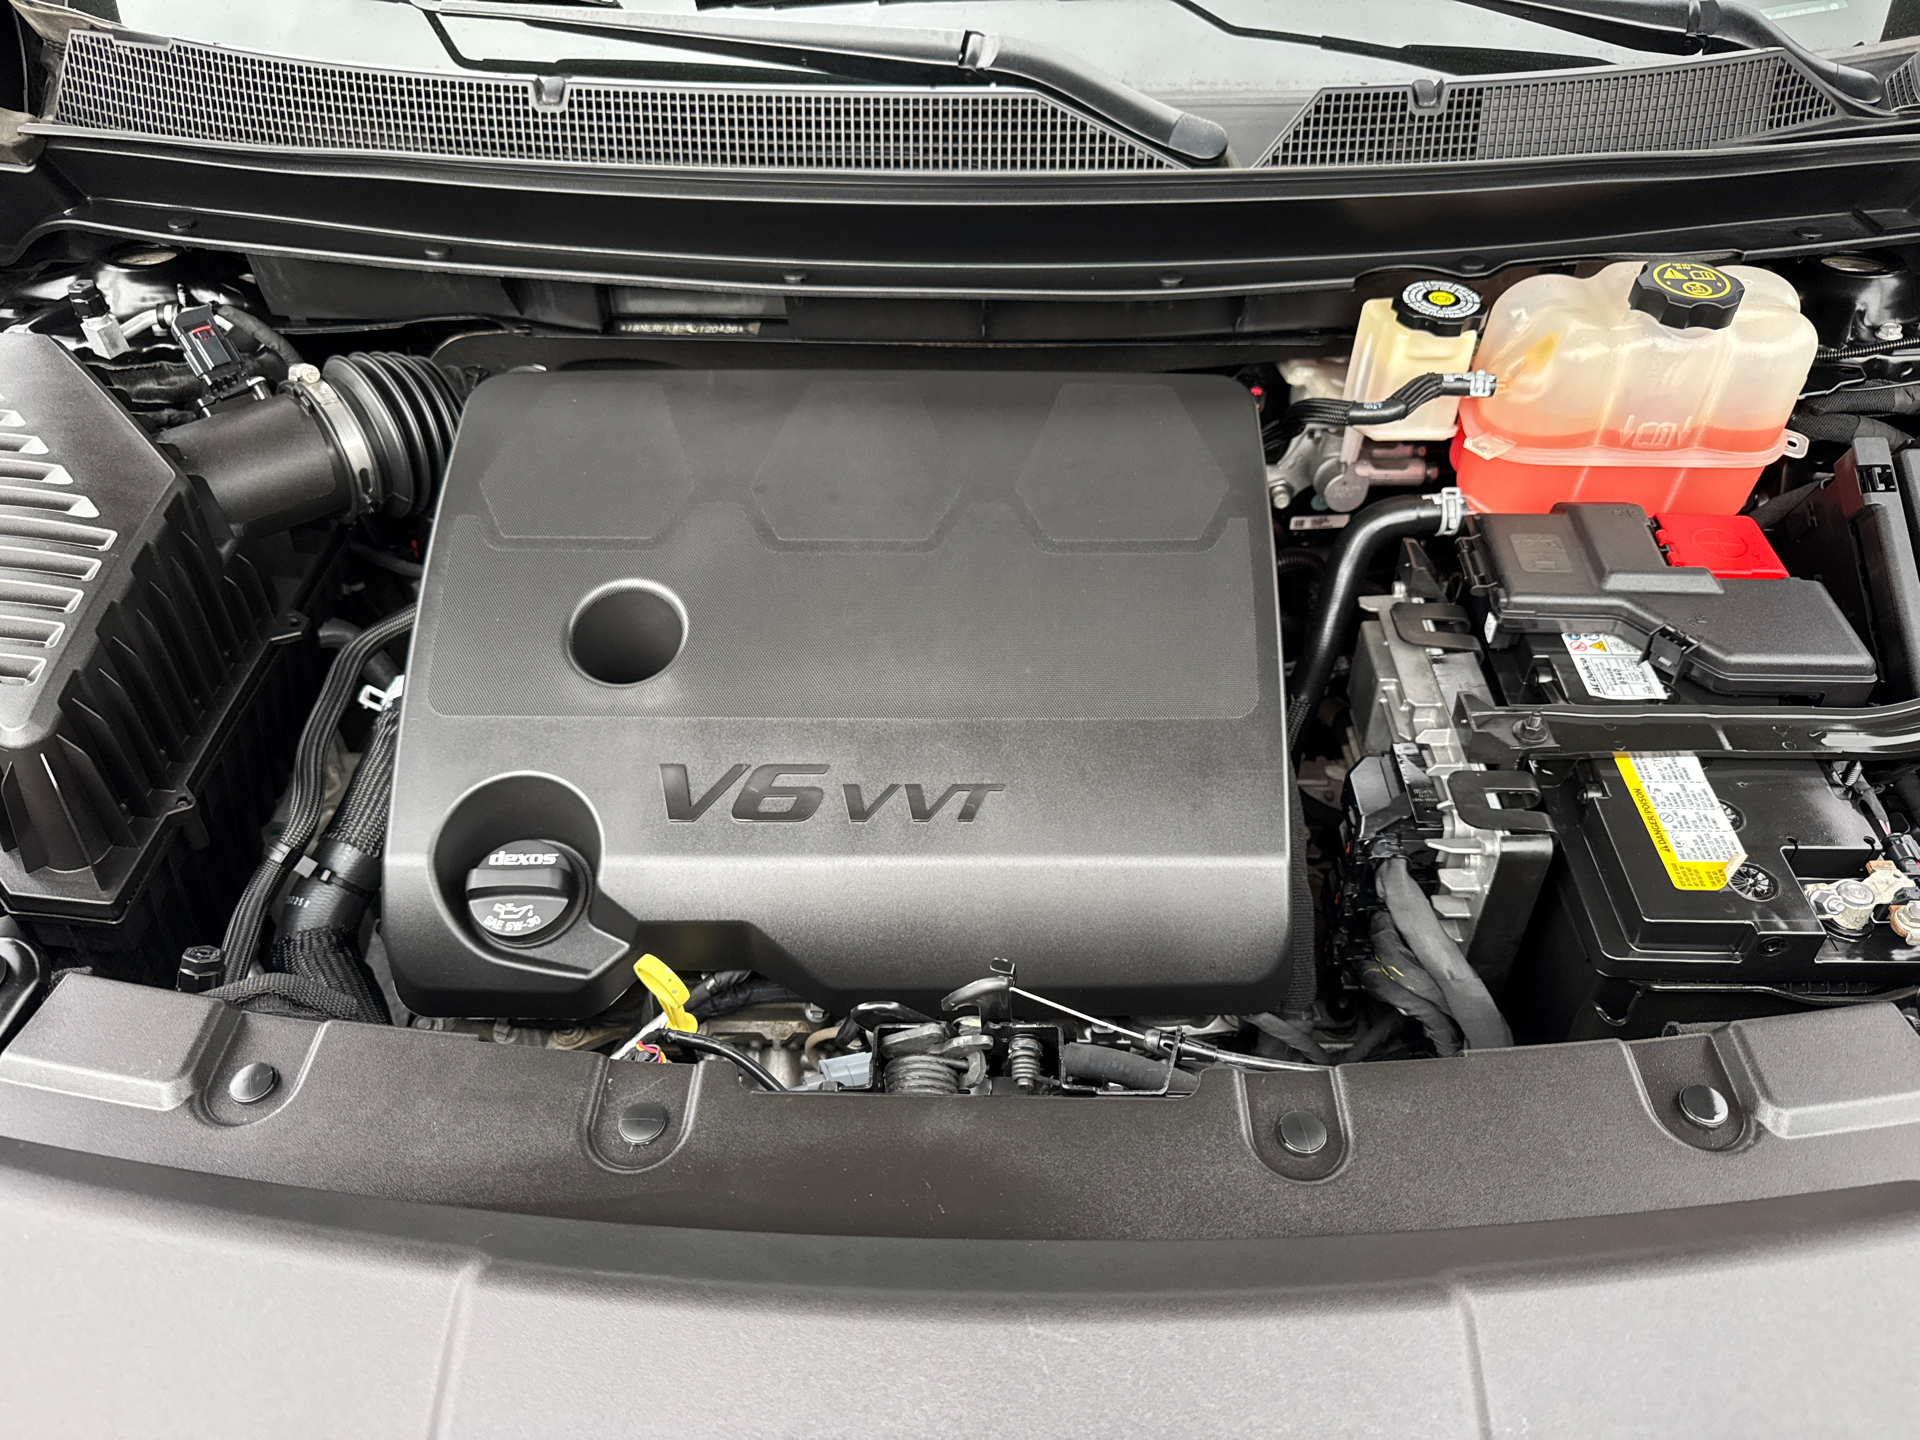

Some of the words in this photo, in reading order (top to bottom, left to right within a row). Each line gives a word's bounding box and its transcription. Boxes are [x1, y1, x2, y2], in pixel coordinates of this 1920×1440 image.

[660, 763, 830, 822] V6
[843, 783, 1006, 822] VVT
[488, 851, 560, 866] dexos
[484, 915, 503, 930] SAE
[504, 915, 542, 931] 5W-30
